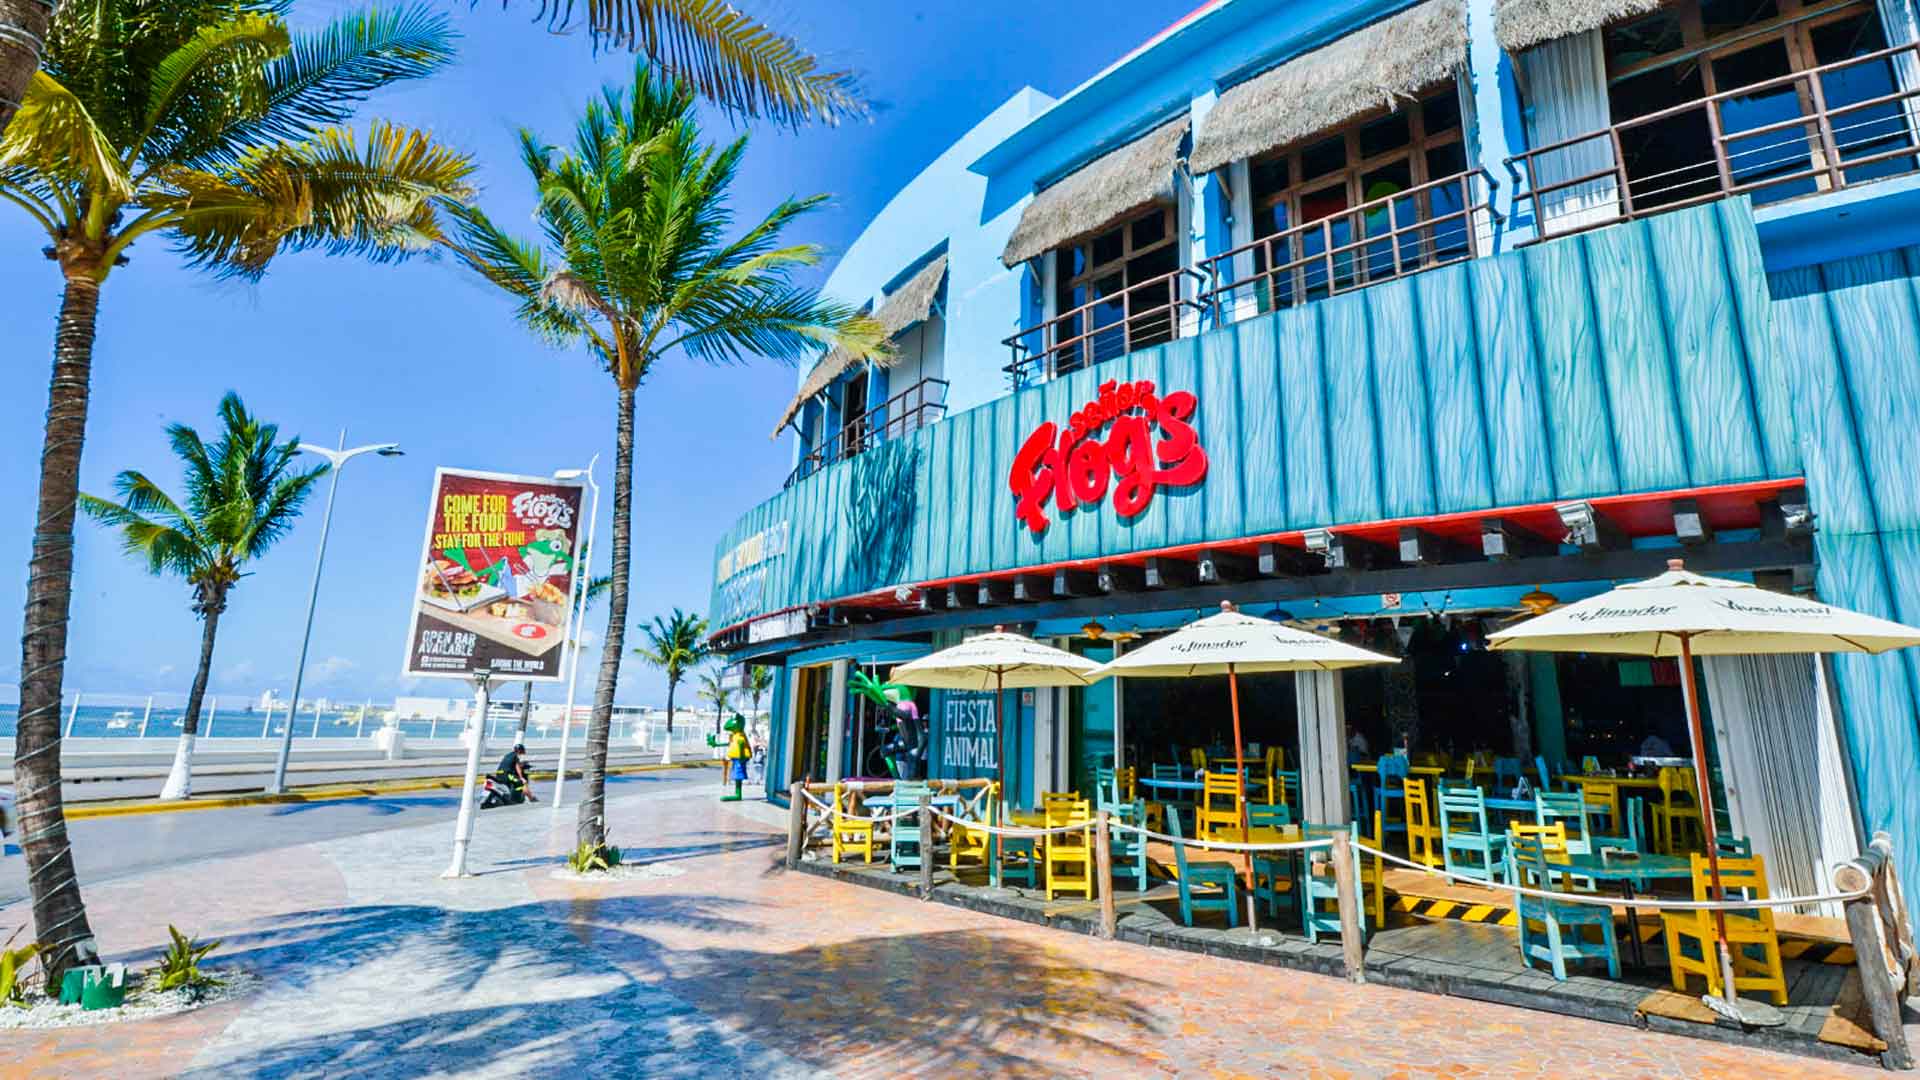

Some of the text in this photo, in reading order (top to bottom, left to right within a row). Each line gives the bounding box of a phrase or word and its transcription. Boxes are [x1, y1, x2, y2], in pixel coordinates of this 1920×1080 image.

[444, 494, 507, 513] COME FOR
[444, 512, 507, 532] THE FOOD
[435, 533, 462, 549] STAY
[463, 533, 481, 548] FOR
[483, 532, 502, 547] THE
[418, 640, 474, 656] AVAILABLE
[422, 630, 477, 647] OPEN BAR
[945, 700, 997, 733] FIESTA
[944, 737, 998, 768] ANIMAL
